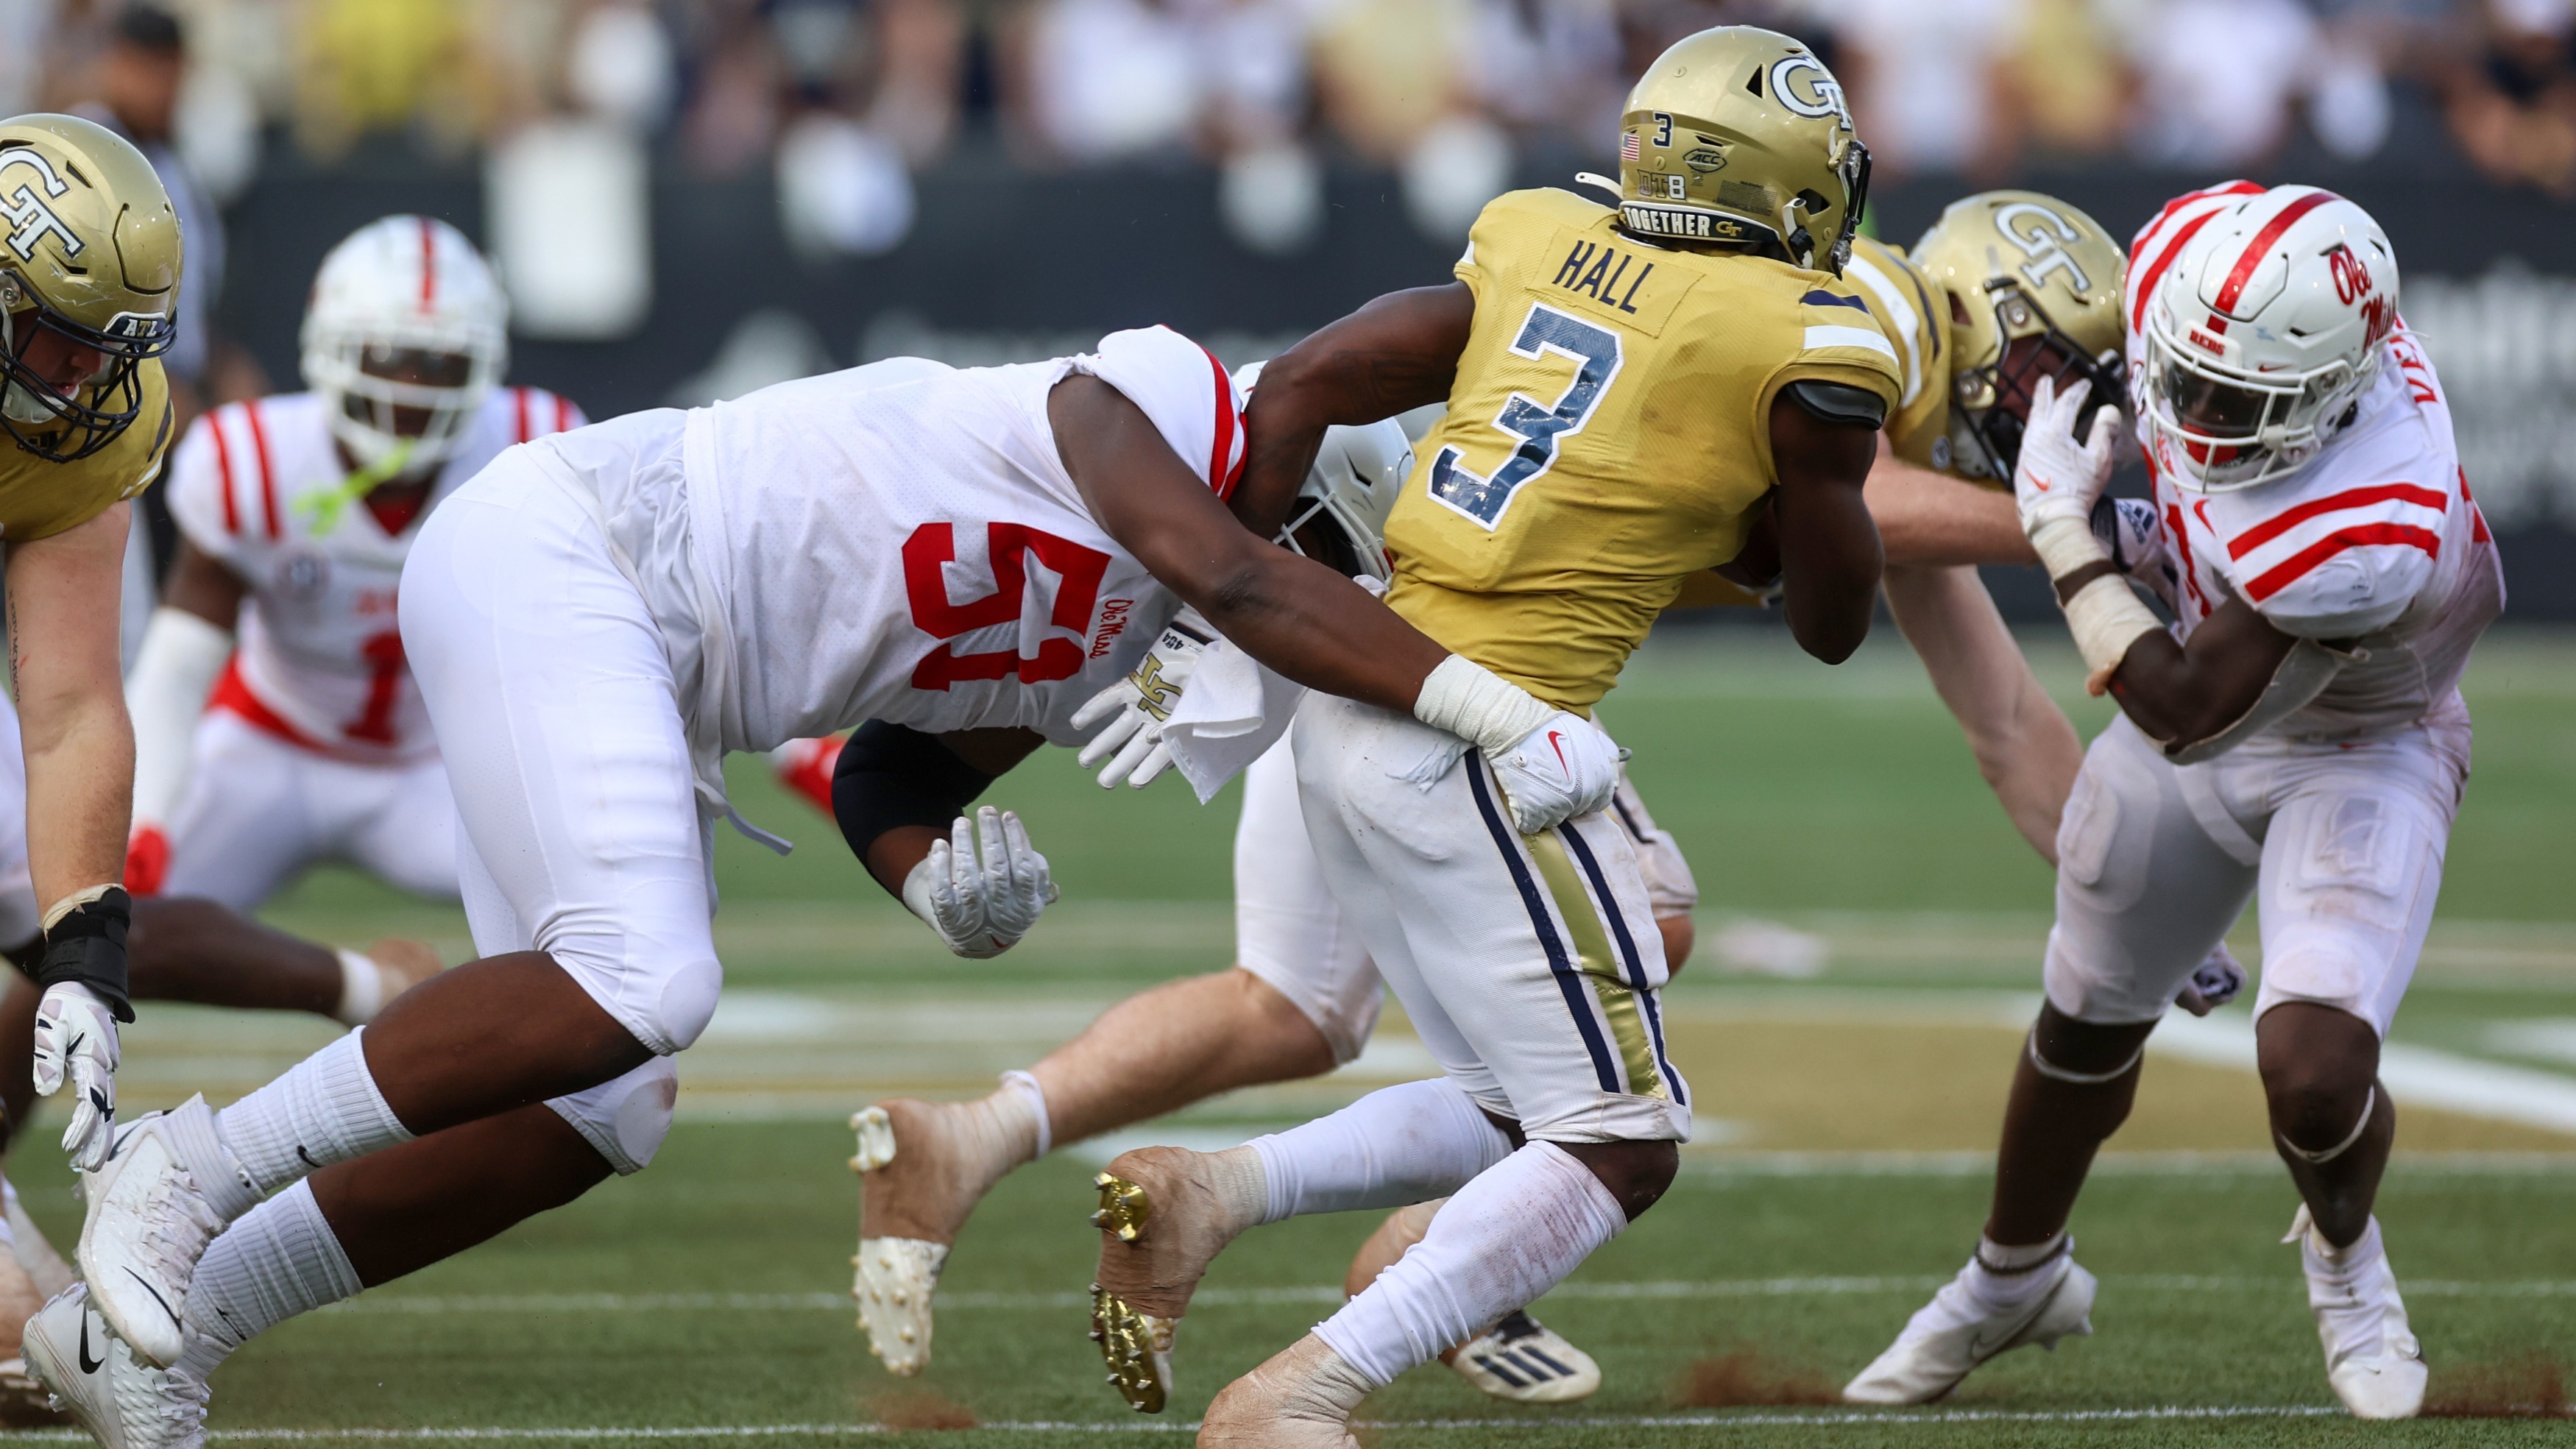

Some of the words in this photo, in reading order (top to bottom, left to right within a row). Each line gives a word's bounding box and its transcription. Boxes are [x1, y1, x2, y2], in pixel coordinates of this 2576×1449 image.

[1652, 112, 1673, 147] 3
[1690, 153, 1720, 166] ACC
[1624, 207, 1711, 237] TOGETHER
[1995, 202, 2092, 292] GT
[1552, 240, 1655, 315] HALL
[2329, 244, 2371, 305] Ole
[123, 319, 158, 337] ATL
[2190, 329, 2226, 356] REBS
[1426, 301, 1625, 532] 3
[902, 521, 1112, 692] 51
[1100, 598, 1134, 623] Ole
[1089, 616, 1128, 659] Miss
